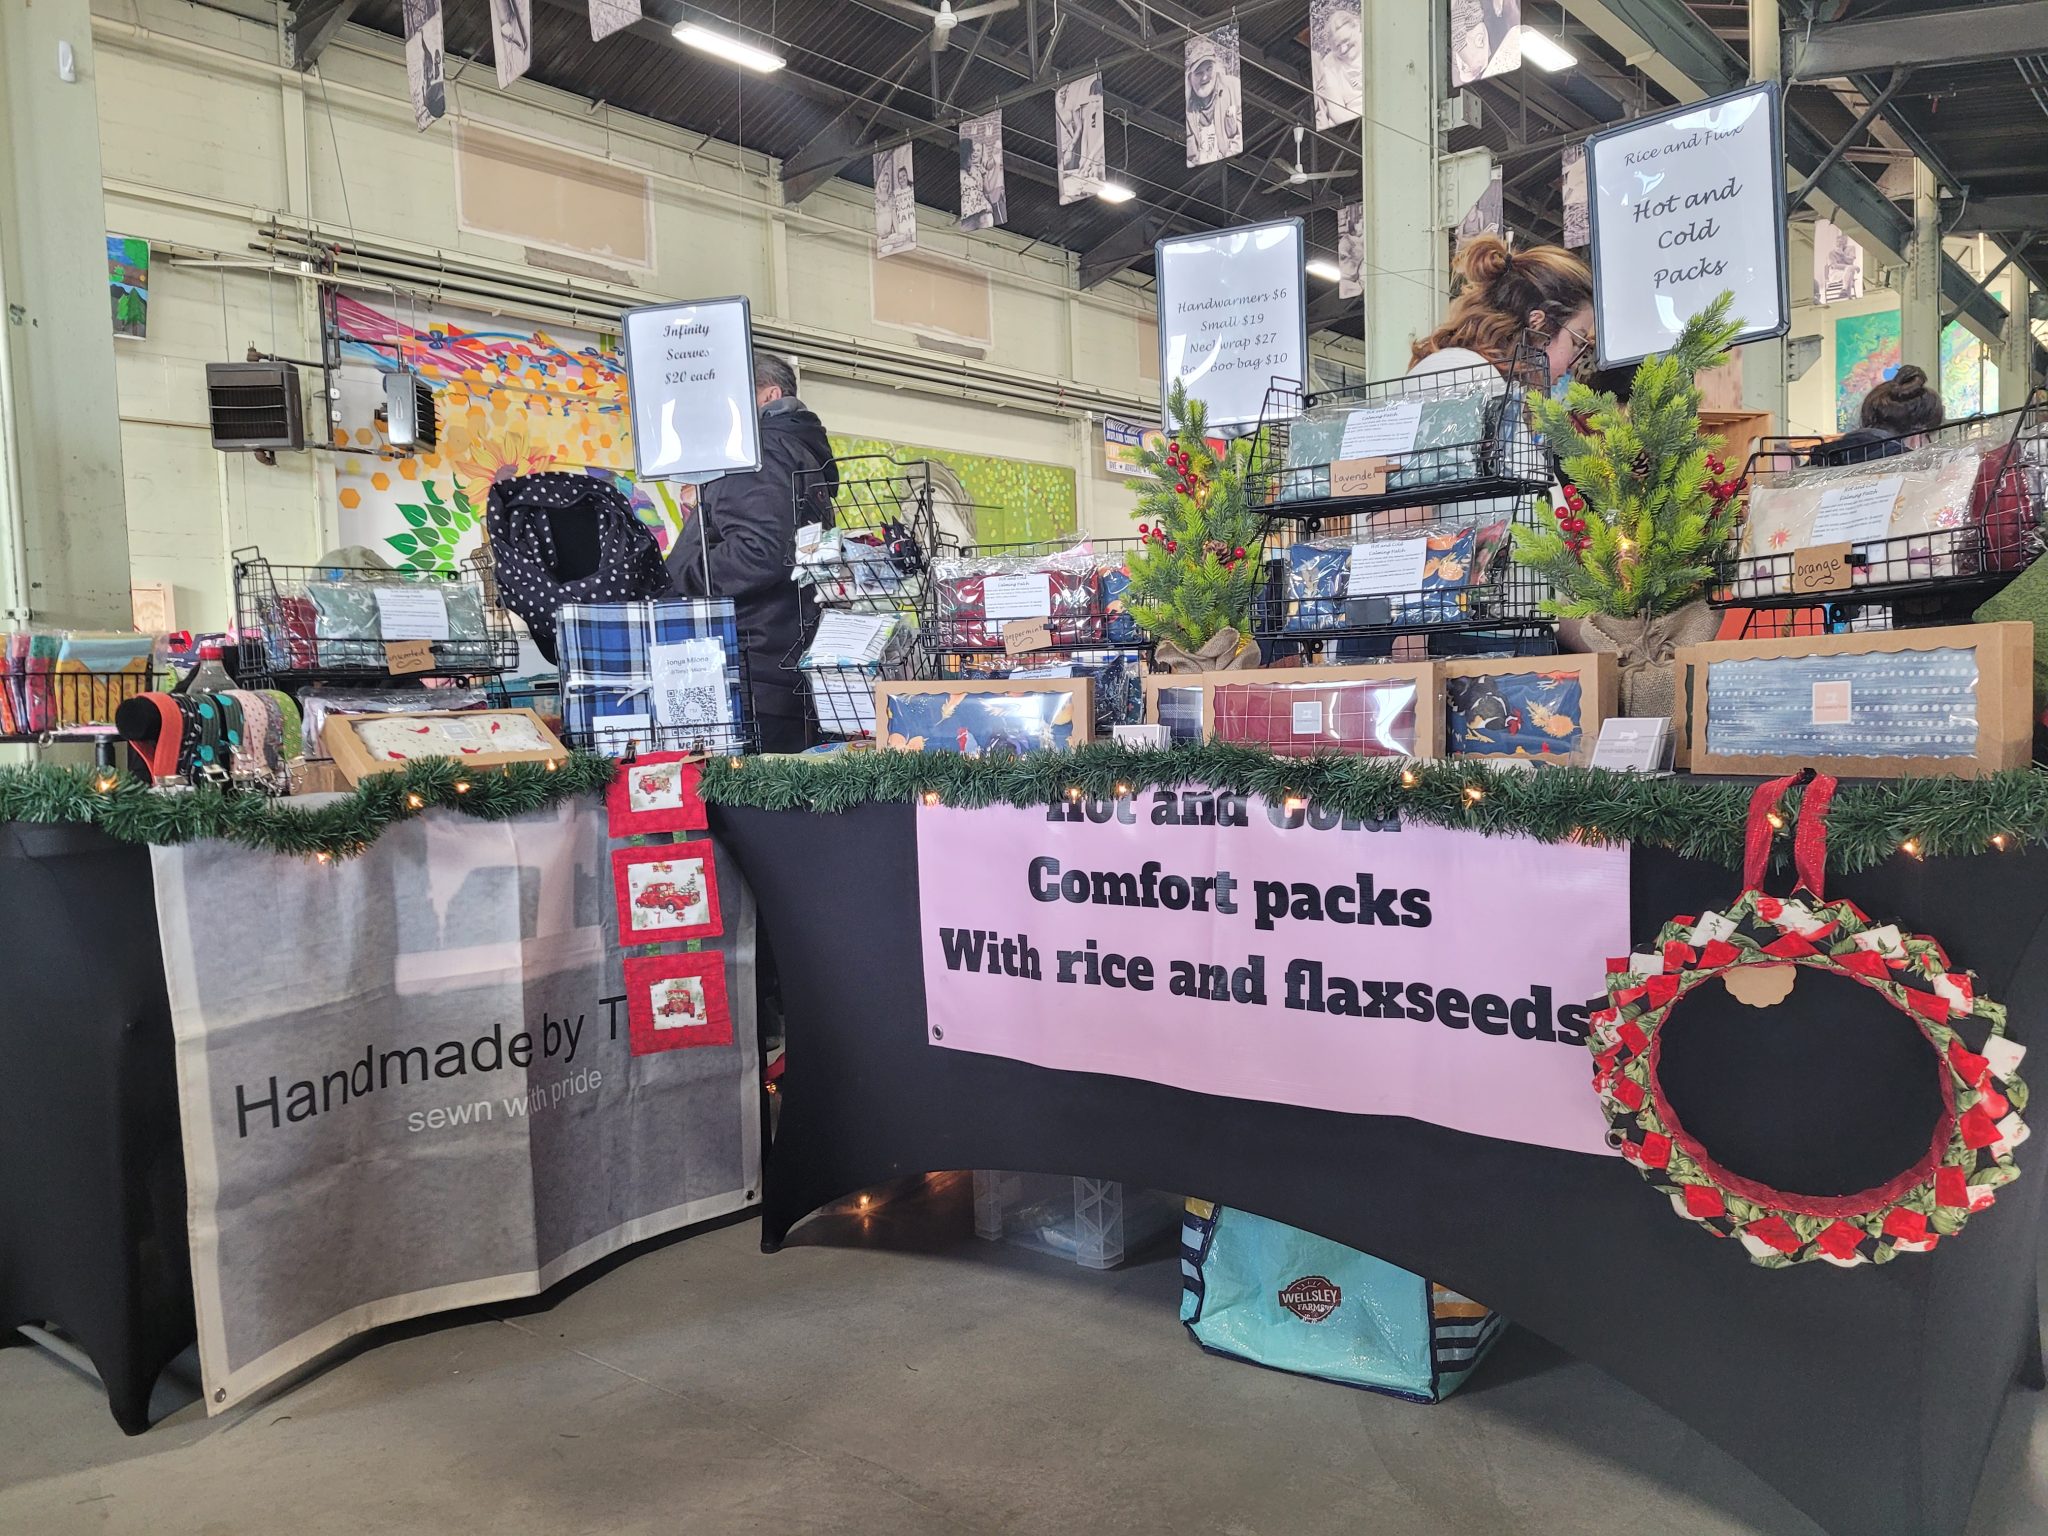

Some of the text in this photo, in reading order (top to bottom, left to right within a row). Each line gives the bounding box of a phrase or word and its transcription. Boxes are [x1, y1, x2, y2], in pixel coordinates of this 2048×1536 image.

[1624, 148, 1661, 167] Rice
[1663, 133, 1702, 155] and
[1632, 177, 1743, 223] Hot and
[1657, 218, 1720, 250] Cold
[1653, 257, 1728, 289] Packs
[1177, 288, 1287, 315] Handwarmers $6
[662, 324, 710, 340] Infinity
[1200, 313, 1265, 332] Small $19
[1254, 332, 1277, 346] $27
[666, 347, 710, 361] Scarves
[1237, 357, 1263, 370] bag
[1265, 352, 1288, 366] $10
[665, 368, 716, 385] $20 each
[1334, 467, 1376, 483] Lavender
[1797, 557, 1841, 578] orange
[1150, 790, 1249, 827] and
[1266, 798, 1402, 832] Co
[1027, 855, 1433, 930] Comfort packs
[938, 927, 1591, 1047] With rice and flaxseeds
[234, 1022, 533, 1139] Handmade
[542, 1011, 585, 1064] by
[407, 1066, 602, 1134] sewn with pride
[1281, 1289, 1338, 1313] WELLSLEY FARMS
